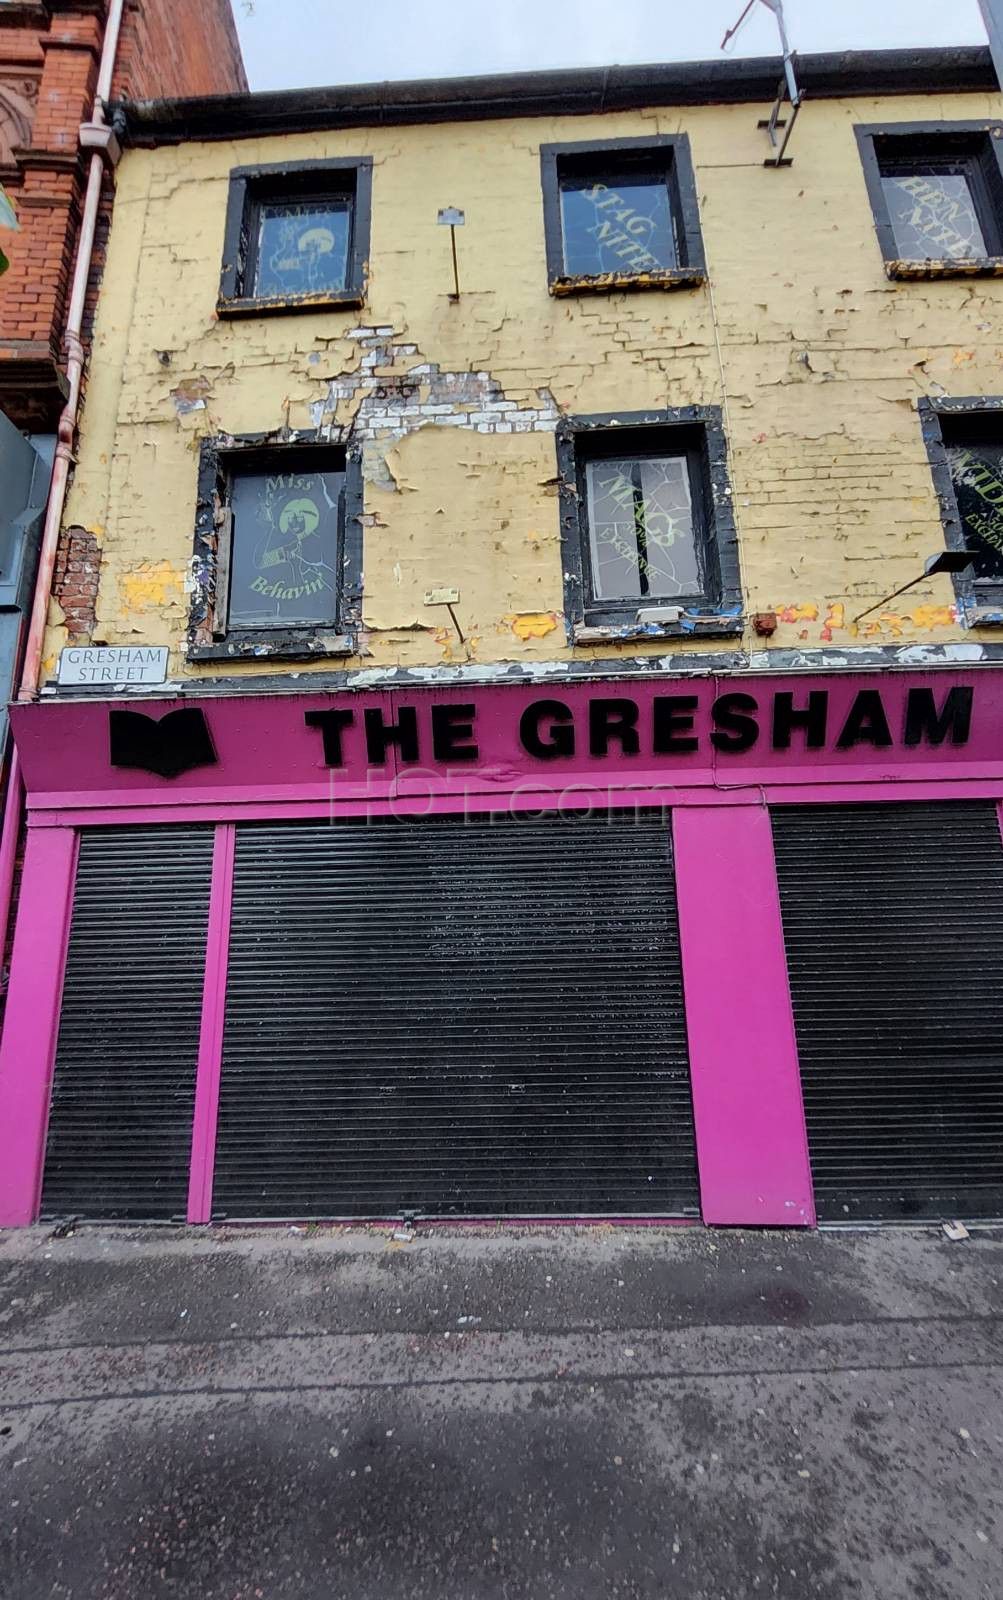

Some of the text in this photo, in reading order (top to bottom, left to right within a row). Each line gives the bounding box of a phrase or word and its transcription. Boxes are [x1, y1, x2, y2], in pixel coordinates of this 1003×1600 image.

[580, 184, 657, 234] STAG
[587, 221, 664, 273] NITE
[265, 473, 315, 492] Miss
[68, 649, 161, 664] GRESHAM
[78, 667, 148, 680] STREET
[305, 686, 974, 767] THE GRESHAM
